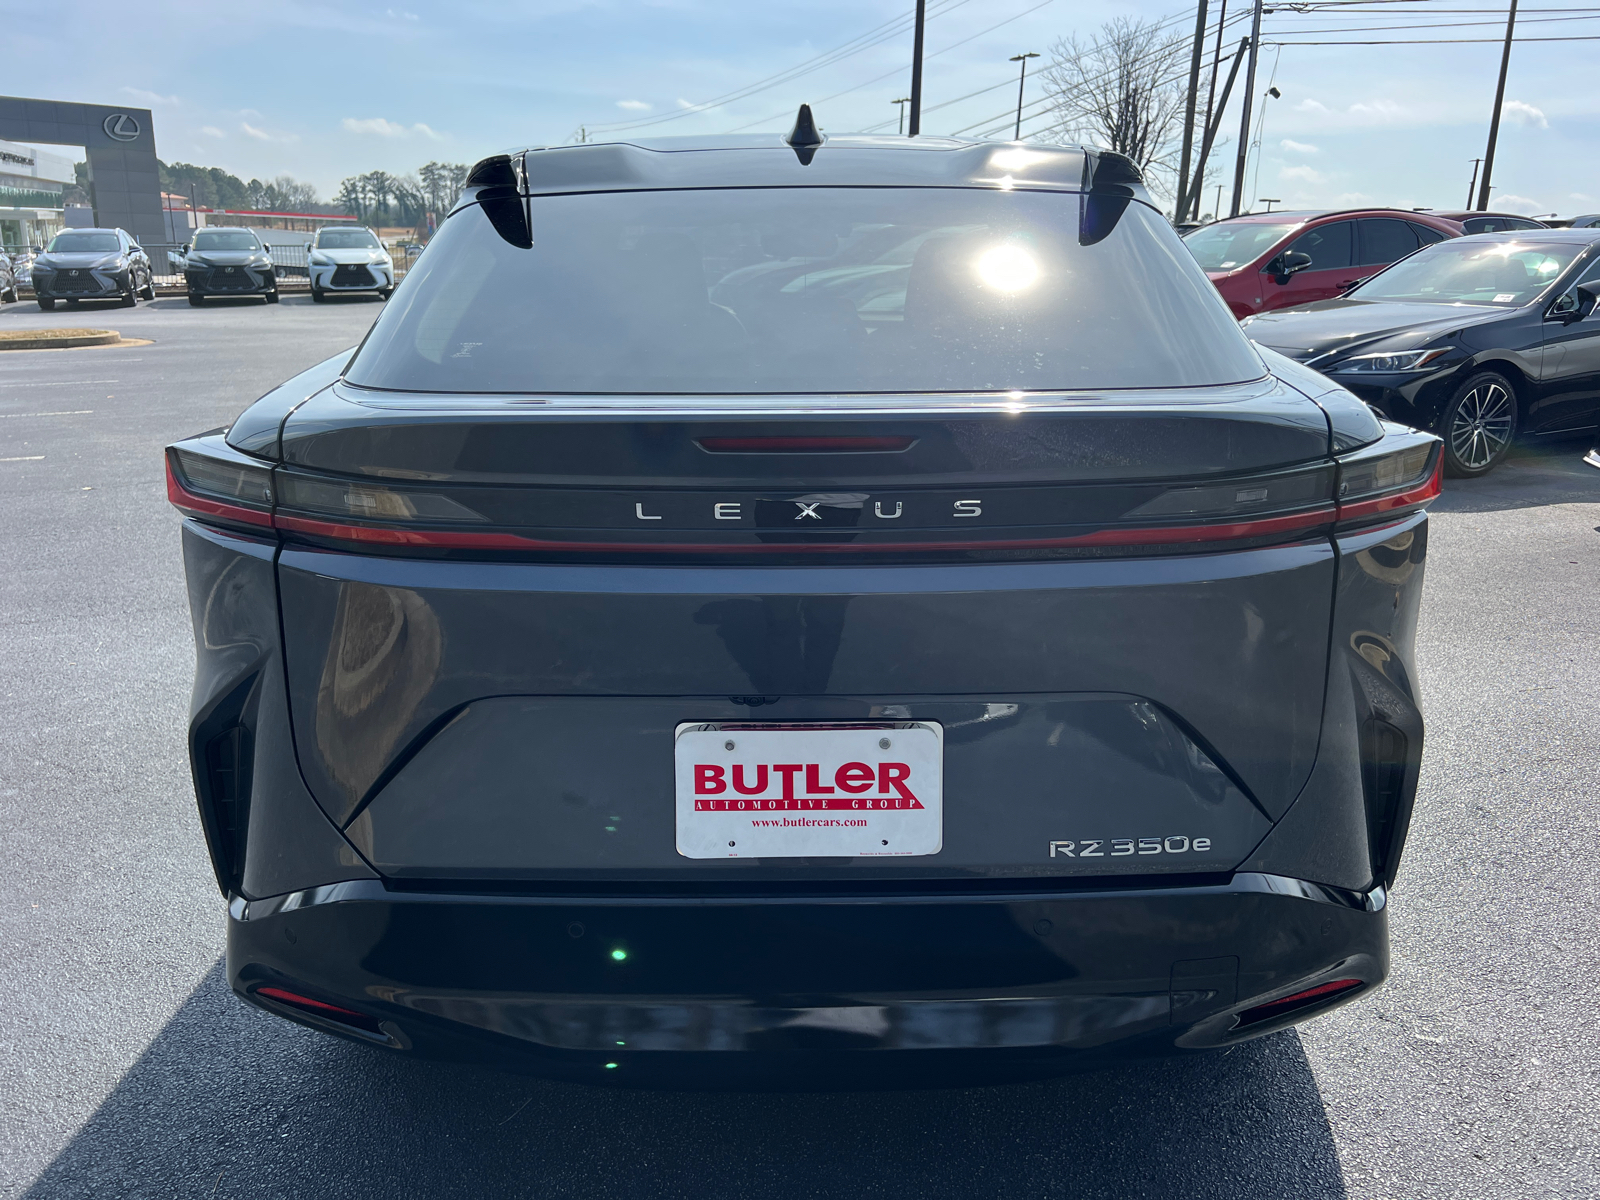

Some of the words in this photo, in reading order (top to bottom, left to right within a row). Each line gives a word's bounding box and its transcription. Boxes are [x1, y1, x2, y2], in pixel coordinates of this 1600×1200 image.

[635, 499, 983, 521] LEXUS
[695, 799, 829, 811] AUTOMOTIVE
[851, 798, 917, 810] GROUP
[751, 816, 868, 829] www.butlercars.com
